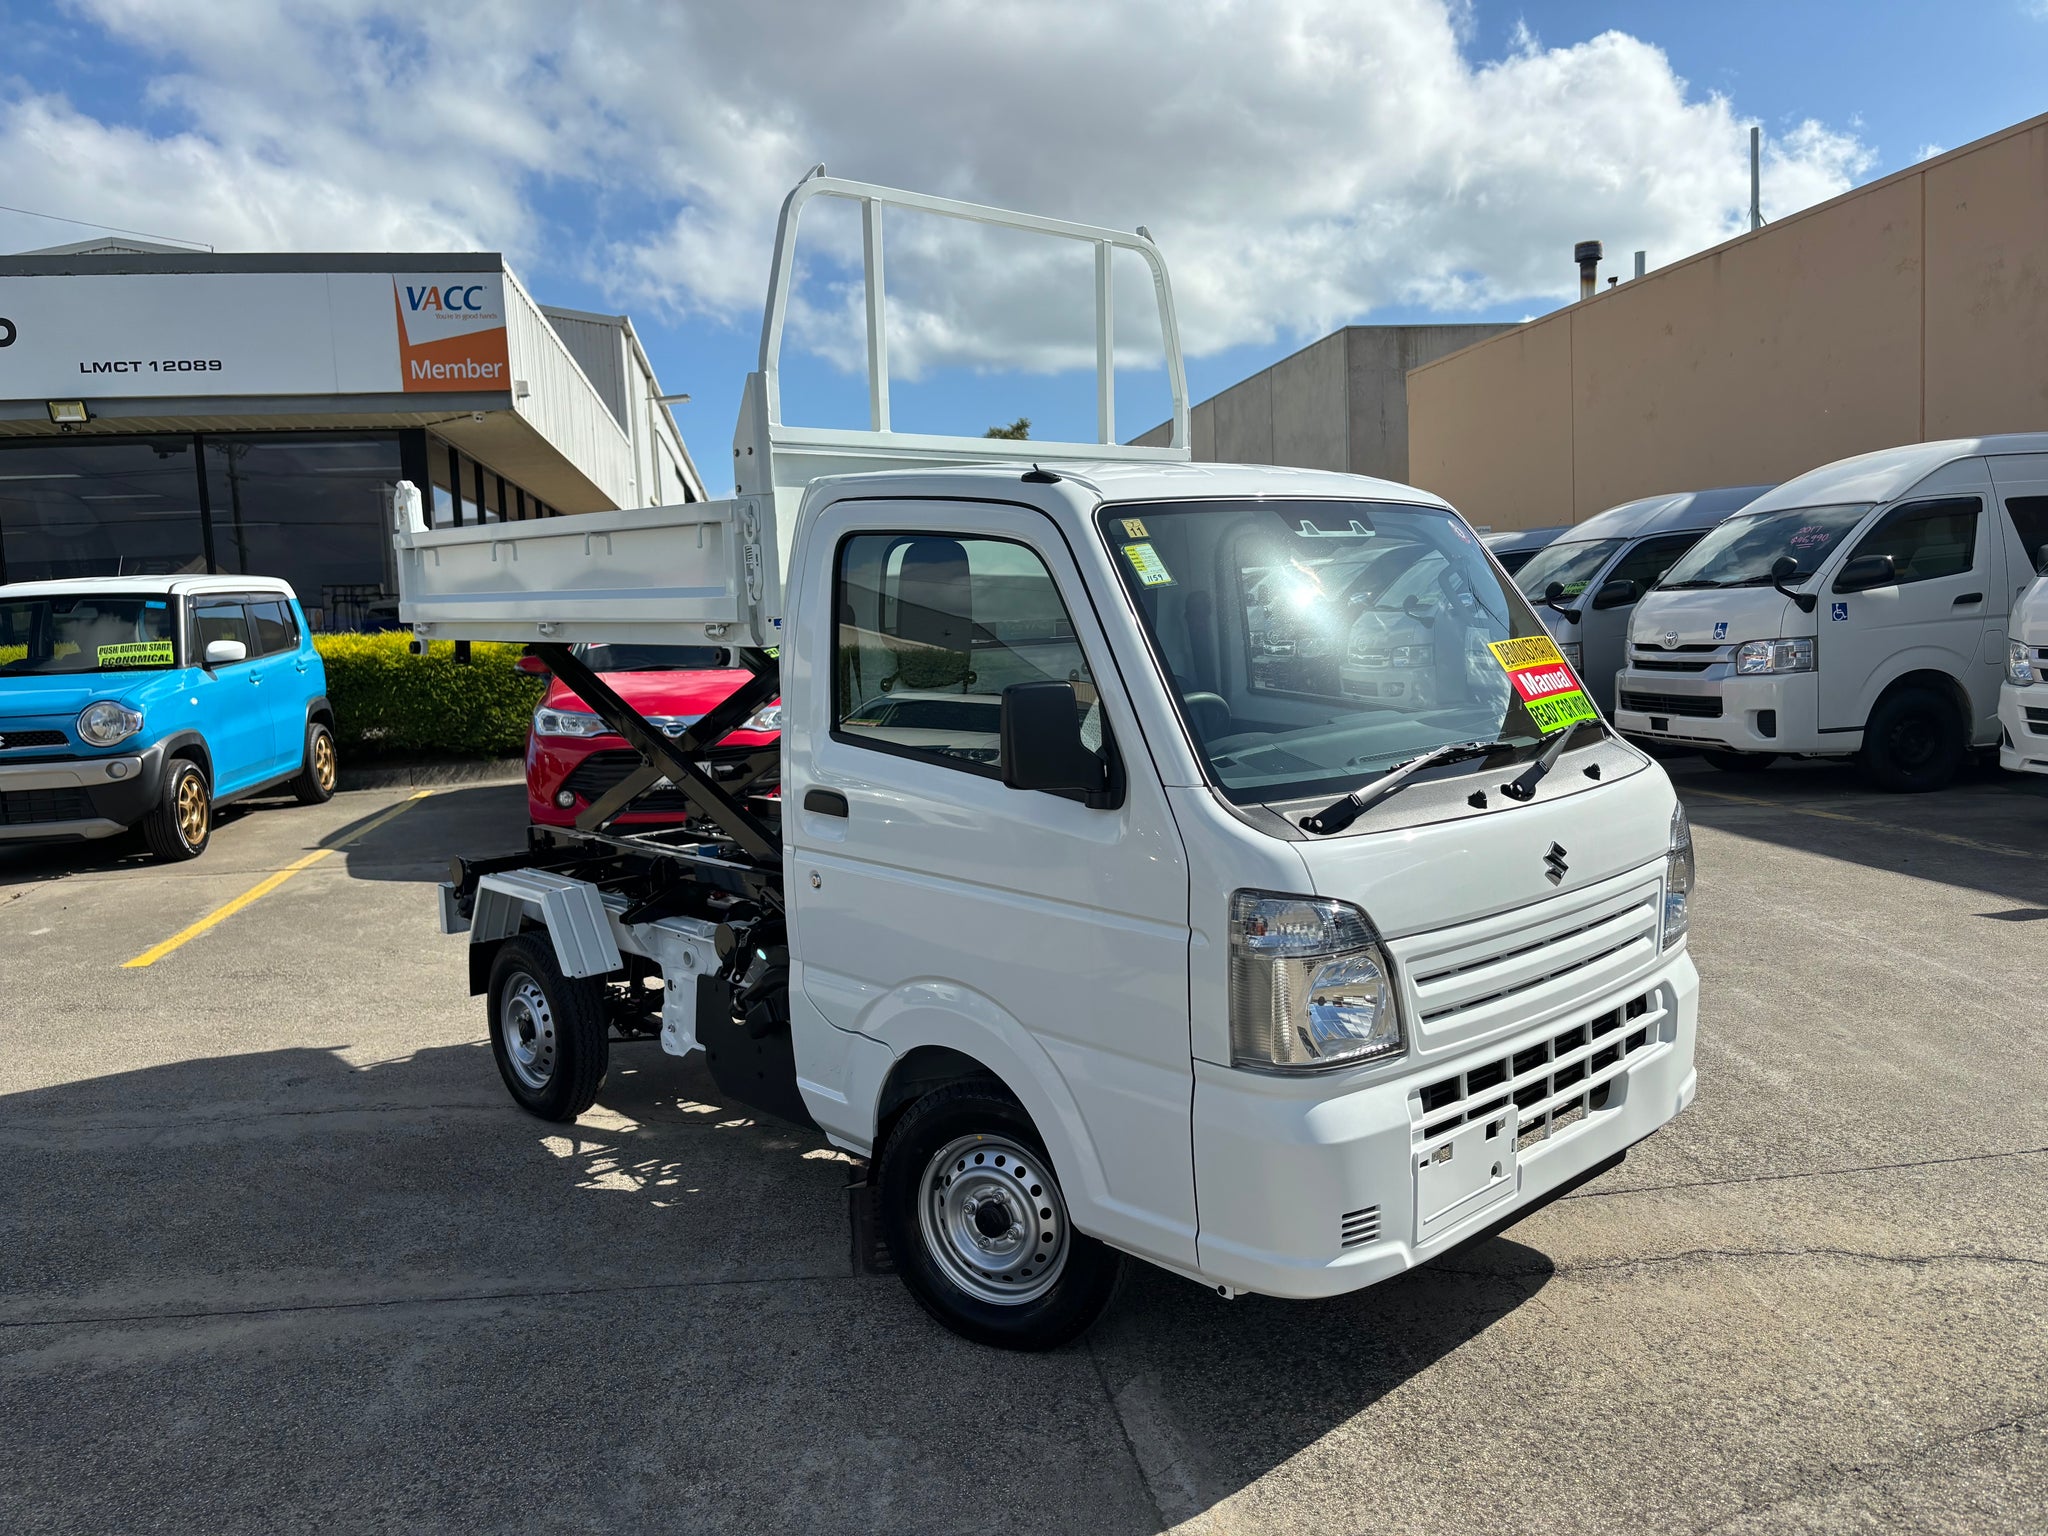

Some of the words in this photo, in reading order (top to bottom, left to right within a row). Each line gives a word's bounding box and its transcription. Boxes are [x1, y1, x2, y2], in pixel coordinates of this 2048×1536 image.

[406, 286, 483, 311] VACC
[462, 313, 478, 321] good
[80, 362, 142, 374] LMCT
[148, 360, 222, 372] 12089
[410, 357, 503, 380] Member
[99, 647, 118, 655] PUSH
[120, 644, 147, 653] BUTTON
[149, 643, 170, 651] START
[102, 654, 172, 665] ECONOMICAL
[1518, 667, 1573, 695] Manual
[1529, 701, 1562, 728] READY
[1556, 698, 1577, 720] FOR
